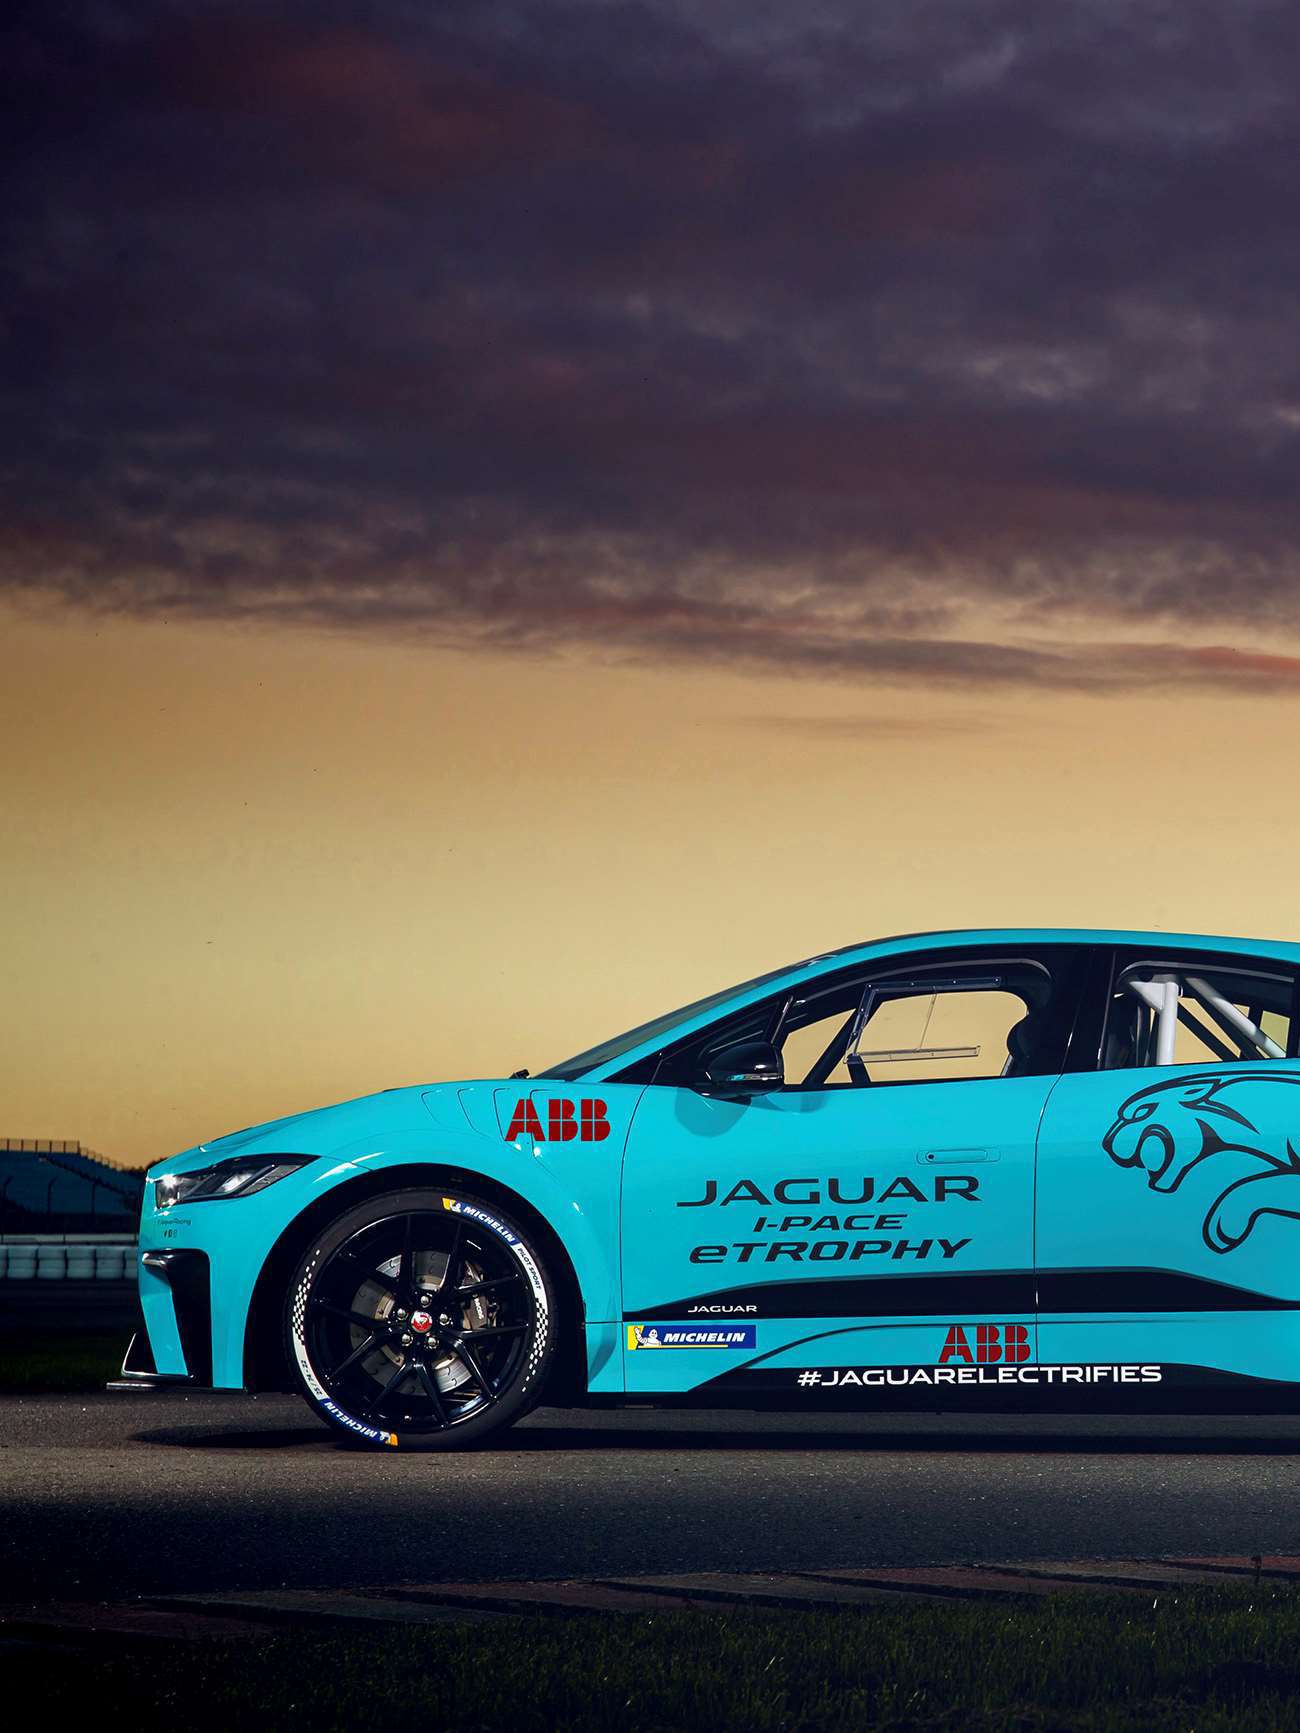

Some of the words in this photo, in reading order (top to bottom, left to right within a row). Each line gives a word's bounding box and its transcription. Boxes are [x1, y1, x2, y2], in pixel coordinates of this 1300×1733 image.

[504, 1099, 611, 1142] ABB
[677, 1175, 983, 1207] JAGUAR
[463, 1206, 516, 1243] MICHELIN
[752, 1214, 908, 1232] I-PACE
[689, 1238, 973, 1264] eTROPHY
[518, 1247, 531, 1267] PILOT
[529, 1267, 541, 1289] SPORT
[687, 1305, 758, 1313] JAGUAR
[663, 1332, 746, 1343] MICHELIN
[938, 1325, 1031, 1363] ABB
[797, 1365, 1162, 1387] #JAGUARELECTRIFIES
[324, 1401, 378, 1438] MICHELIN
